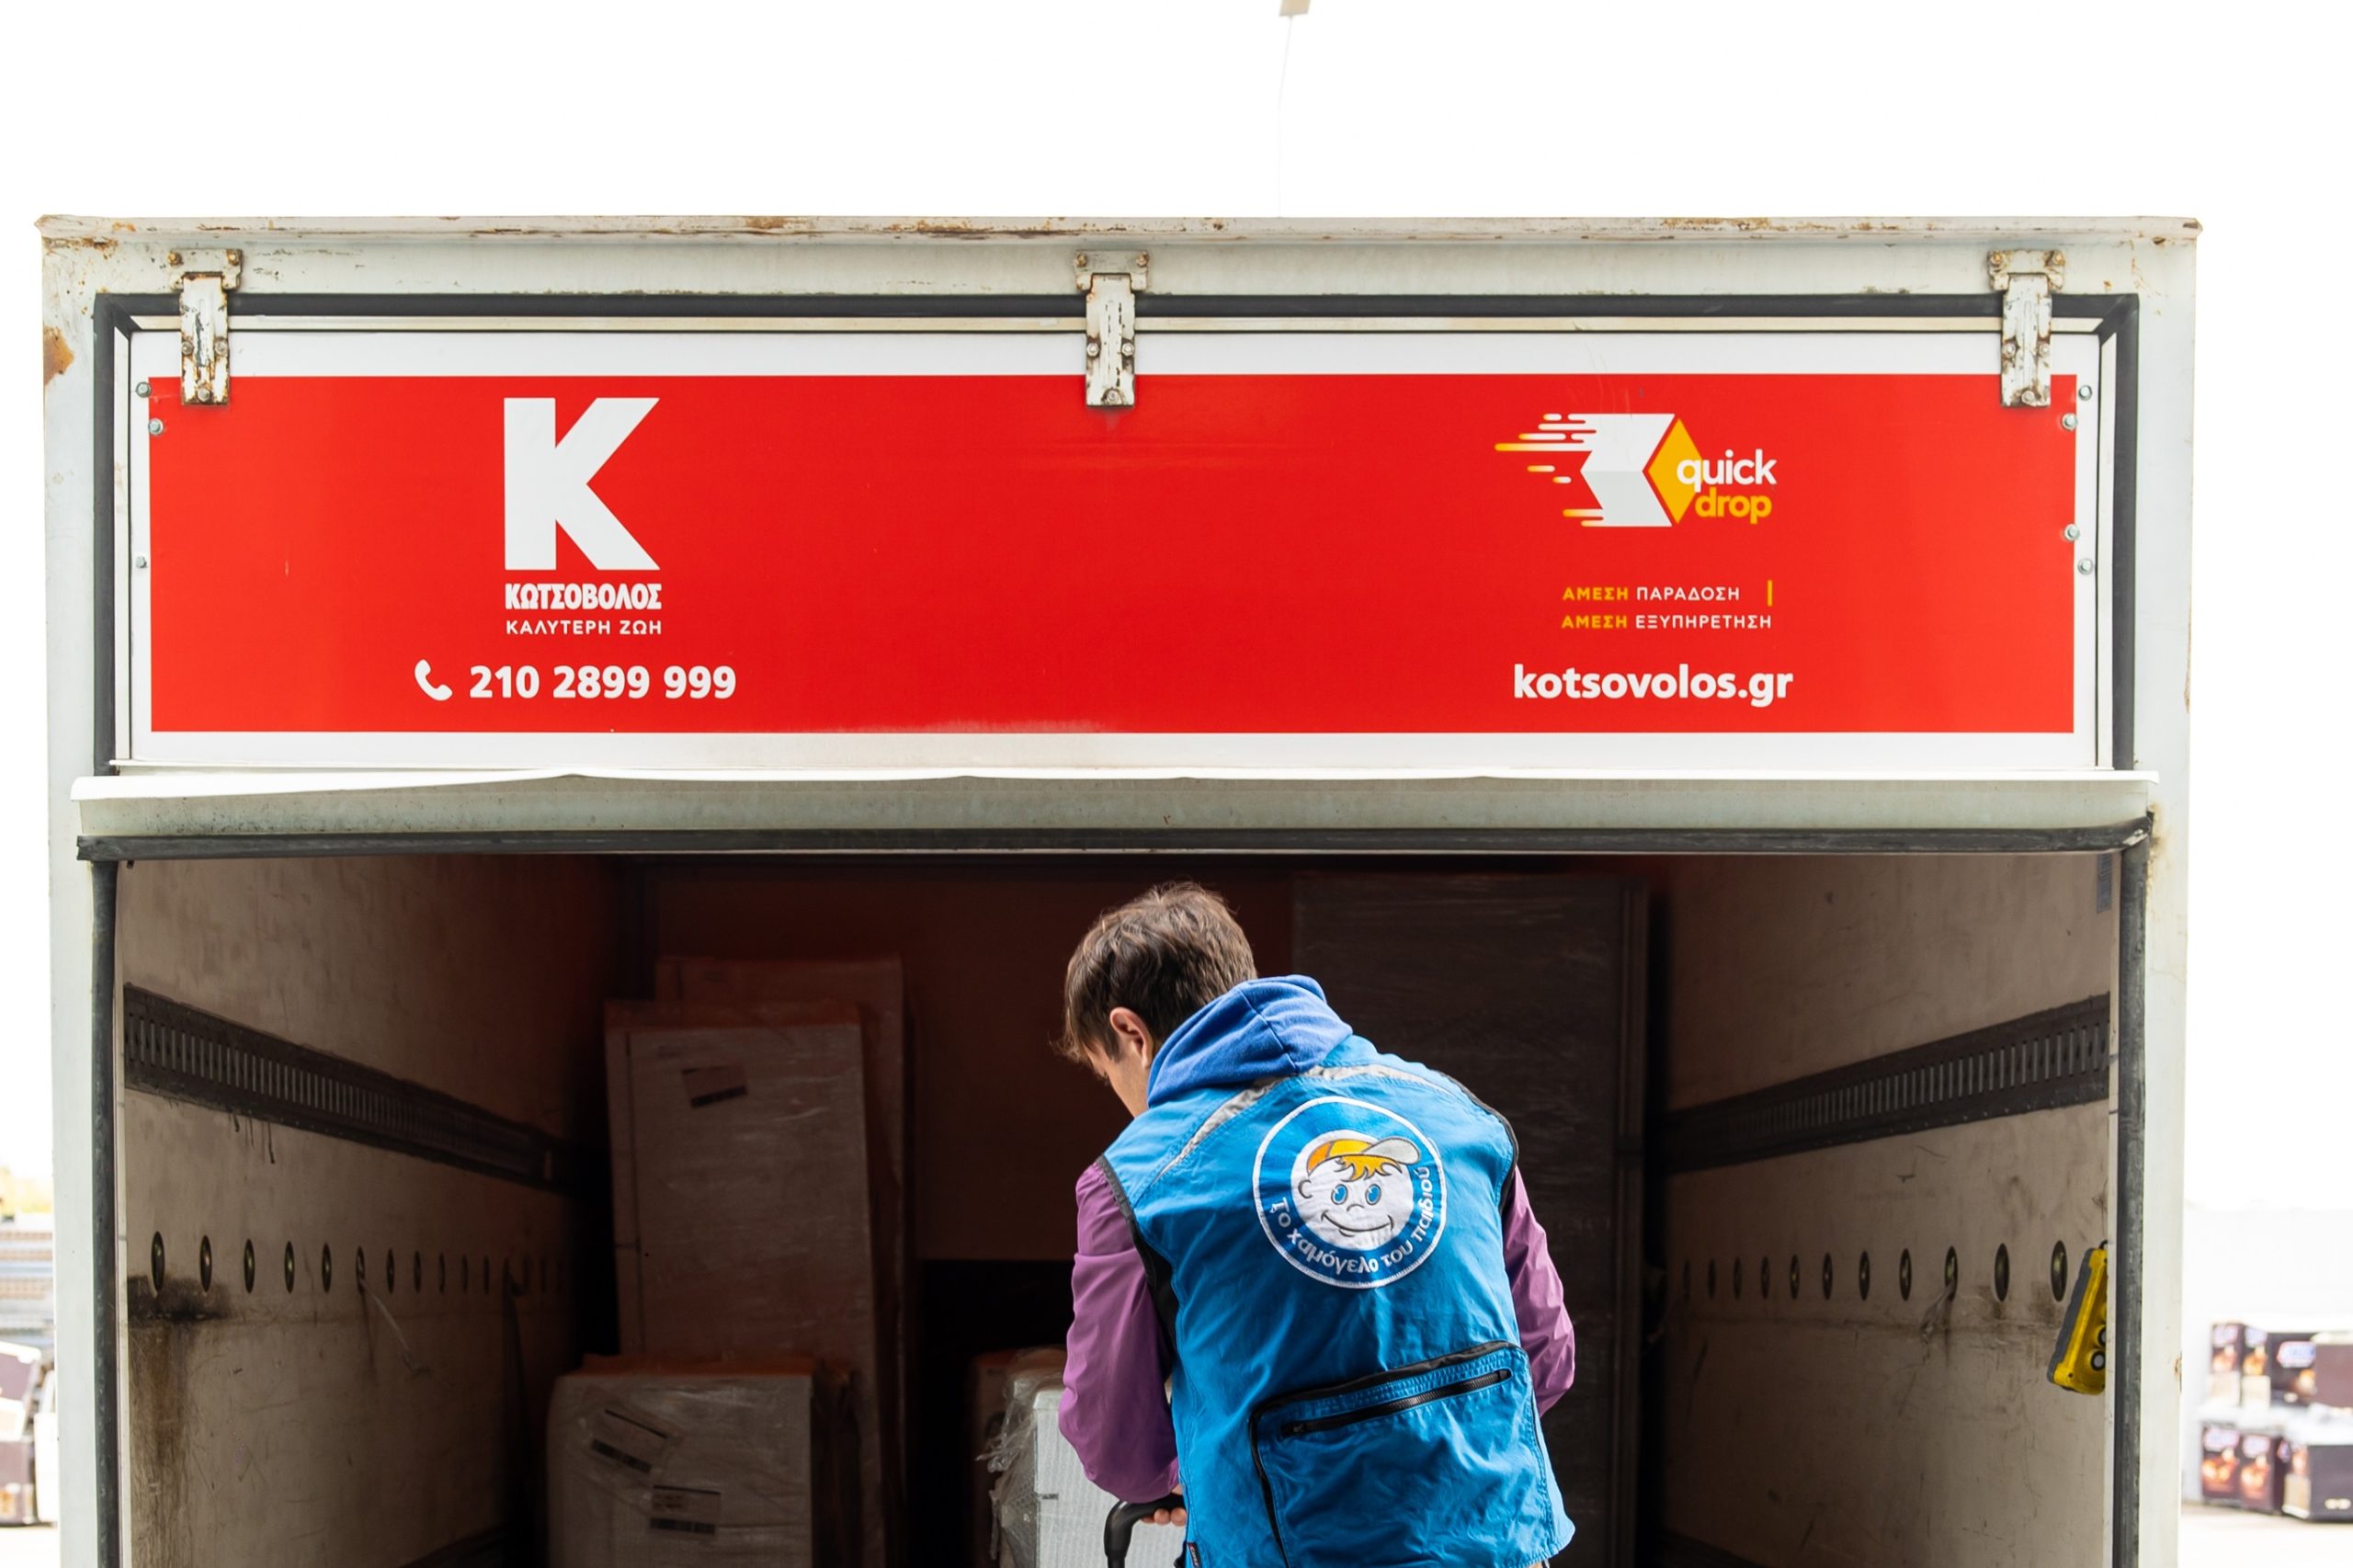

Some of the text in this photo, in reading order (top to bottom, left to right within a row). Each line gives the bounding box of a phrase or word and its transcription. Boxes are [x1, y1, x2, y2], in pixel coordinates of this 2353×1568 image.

[1677, 449, 1778, 493] quick
[1694, 486, 1772, 525] drop
[505, 583, 662, 610] ΚΩΤΣΟΒΟΛΟΣ
[1563, 586, 1740, 601] ΑΜΕΣΗ ΠΑΡΑΔΟΣΗ
[506, 619, 662, 635] ΚΑΛΥΤΕΡΗ ΖΩΗ
[1562, 614, 1772, 629] ΑΜΕΣΗ ΕΞΥΠΗΡΕΤΗΣΗ
[469, 665, 736, 699] 210 2899 999
[1514, 664, 1794, 708] kotsovolos.gr
[1287, 1228, 1379, 1275] χαμόγελο
[1380, 1240, 1414, 1268] του
[1411, 1166, 1435, 1243] παιδιού
